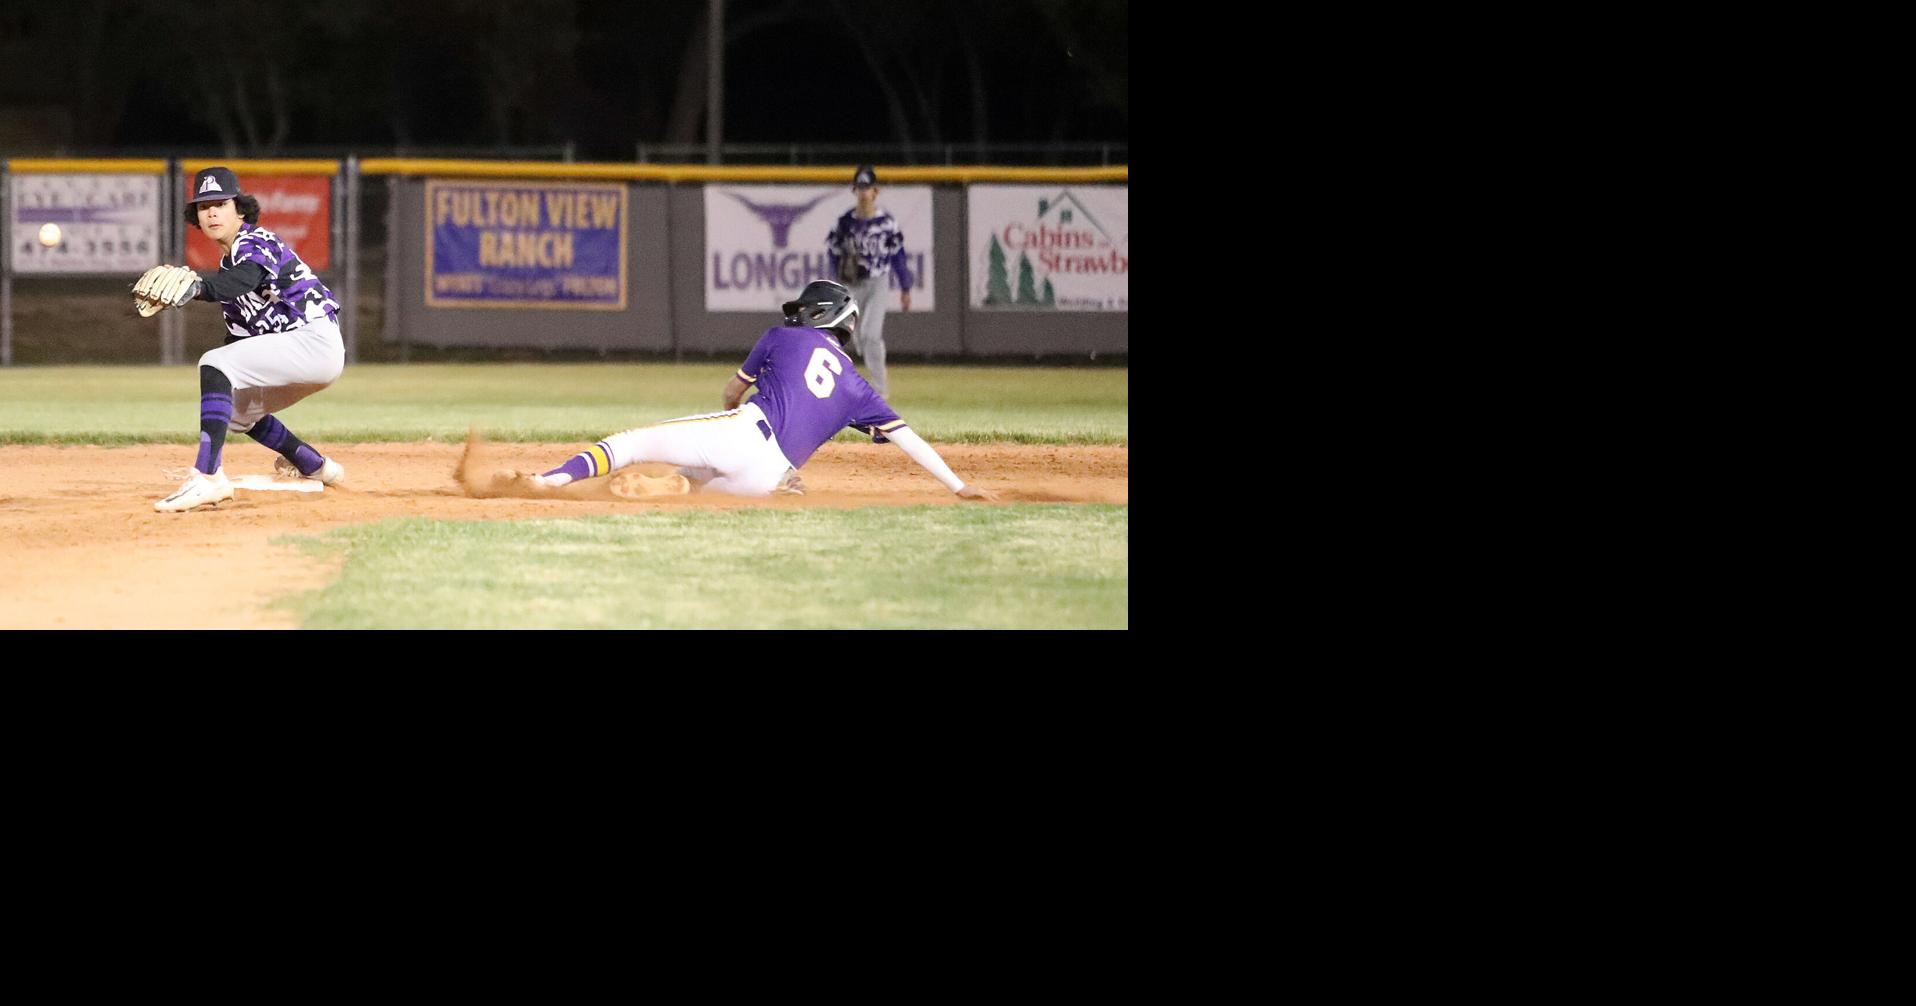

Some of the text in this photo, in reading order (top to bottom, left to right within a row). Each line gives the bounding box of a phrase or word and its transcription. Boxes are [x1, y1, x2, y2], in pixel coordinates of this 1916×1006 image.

[437, 190, 617, 229] FULTON VIEW
[480, 231, 573, 269] RANCH
[1003, 221, 1094, 249] Cabins
[803, 347, 843, 399] 6
